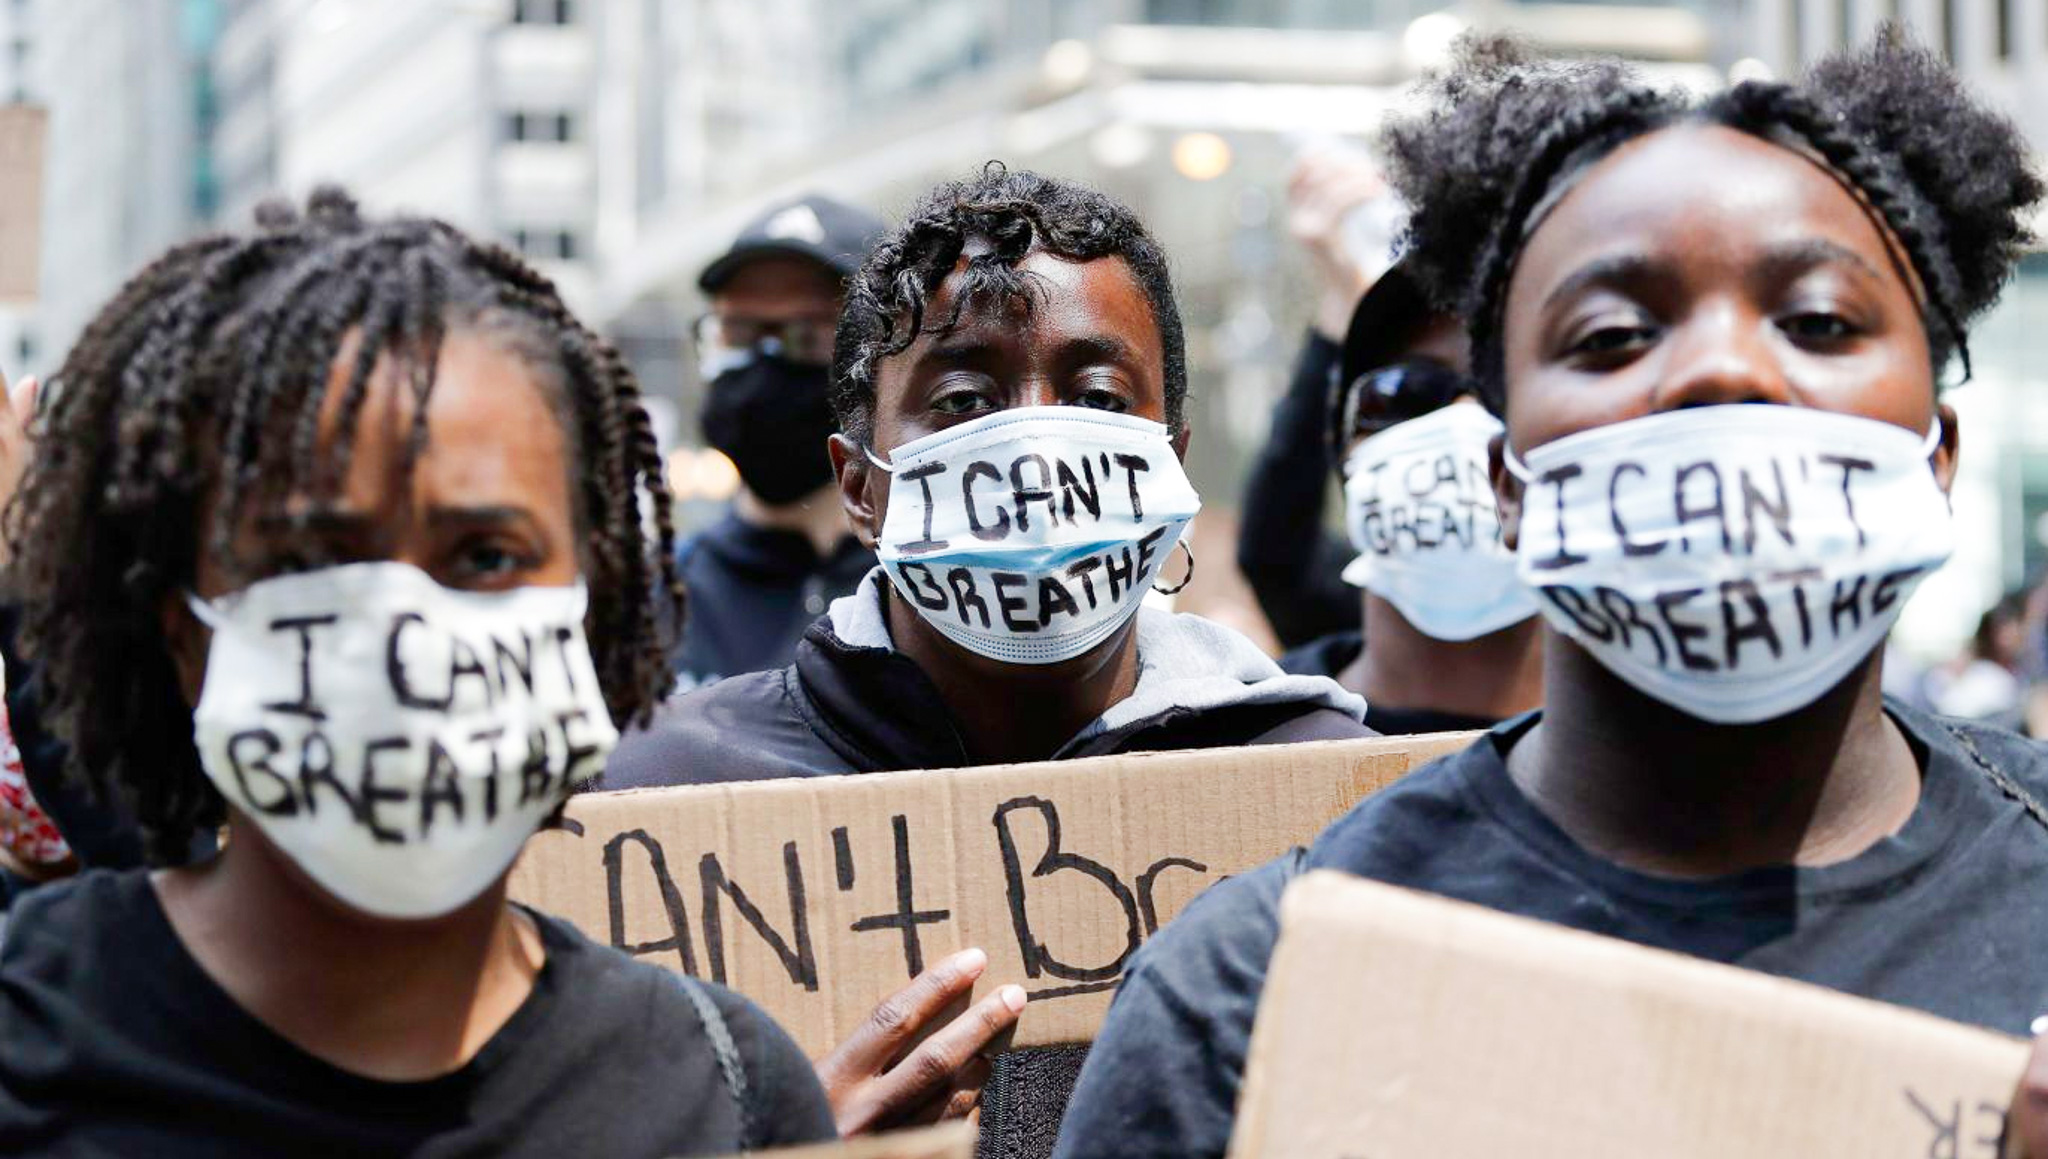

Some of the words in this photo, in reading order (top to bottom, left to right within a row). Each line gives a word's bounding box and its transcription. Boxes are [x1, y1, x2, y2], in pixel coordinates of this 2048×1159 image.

[895, 460, 949, 553] I
[961, 451, 1149, 541] CAN'T
[1533, 464, 1589, 569] I
[1608, 455, 1875, 557] CAN'T
[897, 525, 1167, 632] BREATHE
[1540, 566, 1925, 671] BREATHE
[261, 612, 337, 721] I
[227, 710, 598, 844] BREATHE
